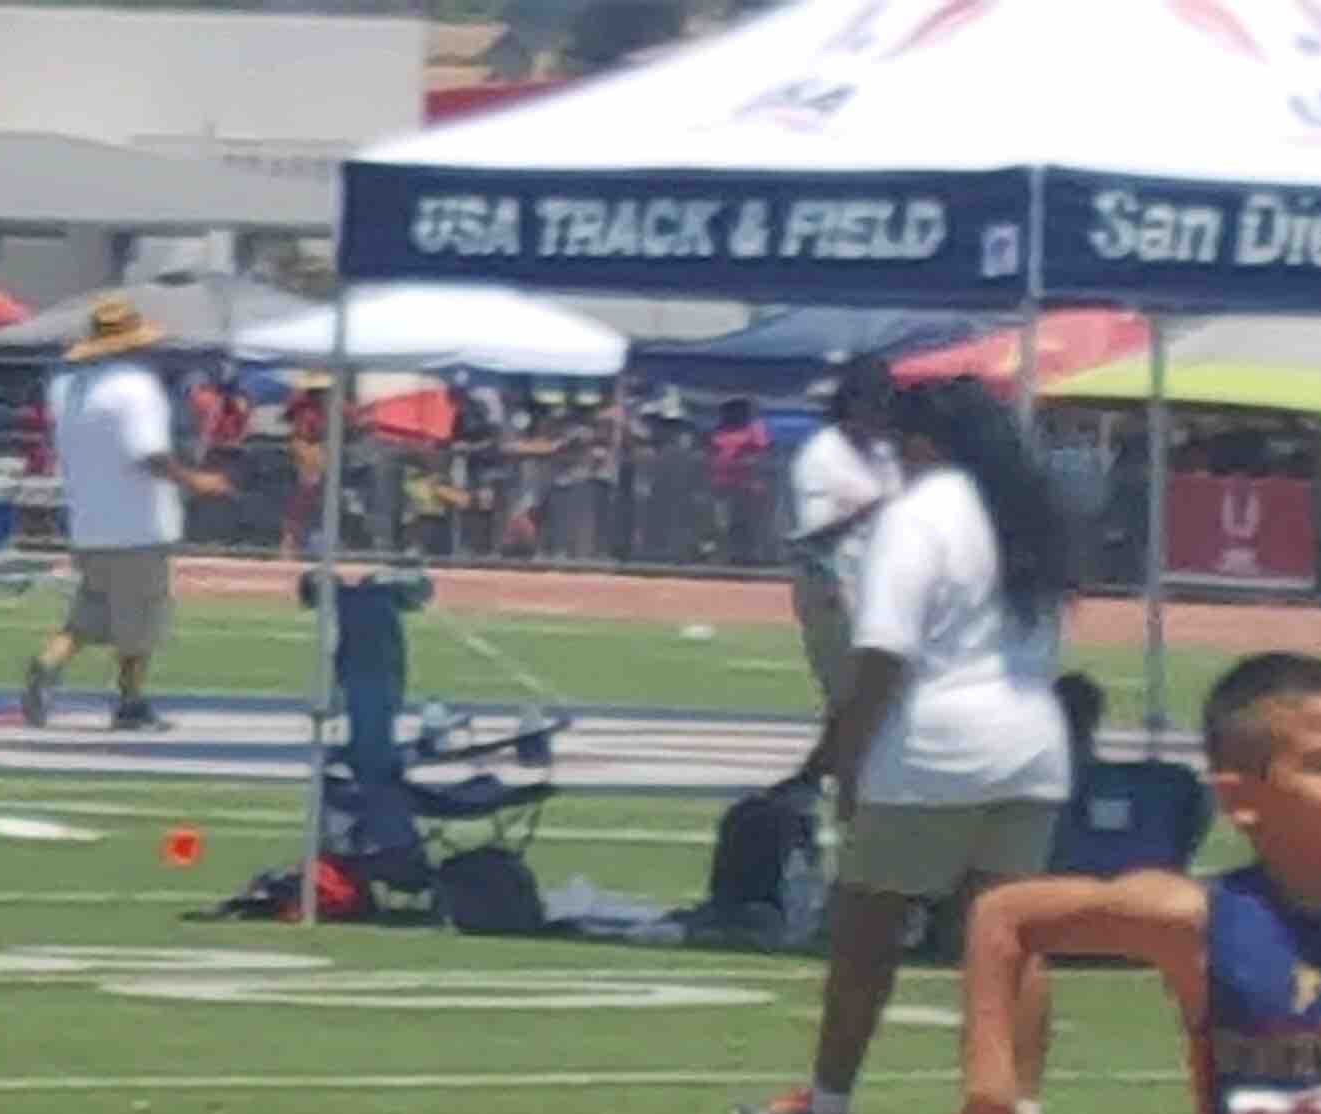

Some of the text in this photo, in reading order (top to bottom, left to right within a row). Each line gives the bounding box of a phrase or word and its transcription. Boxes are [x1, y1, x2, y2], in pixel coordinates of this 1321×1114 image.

[411, 194, 947, 259] USA TRACK & FIELD
[1090, 189, 1221, 264] San
